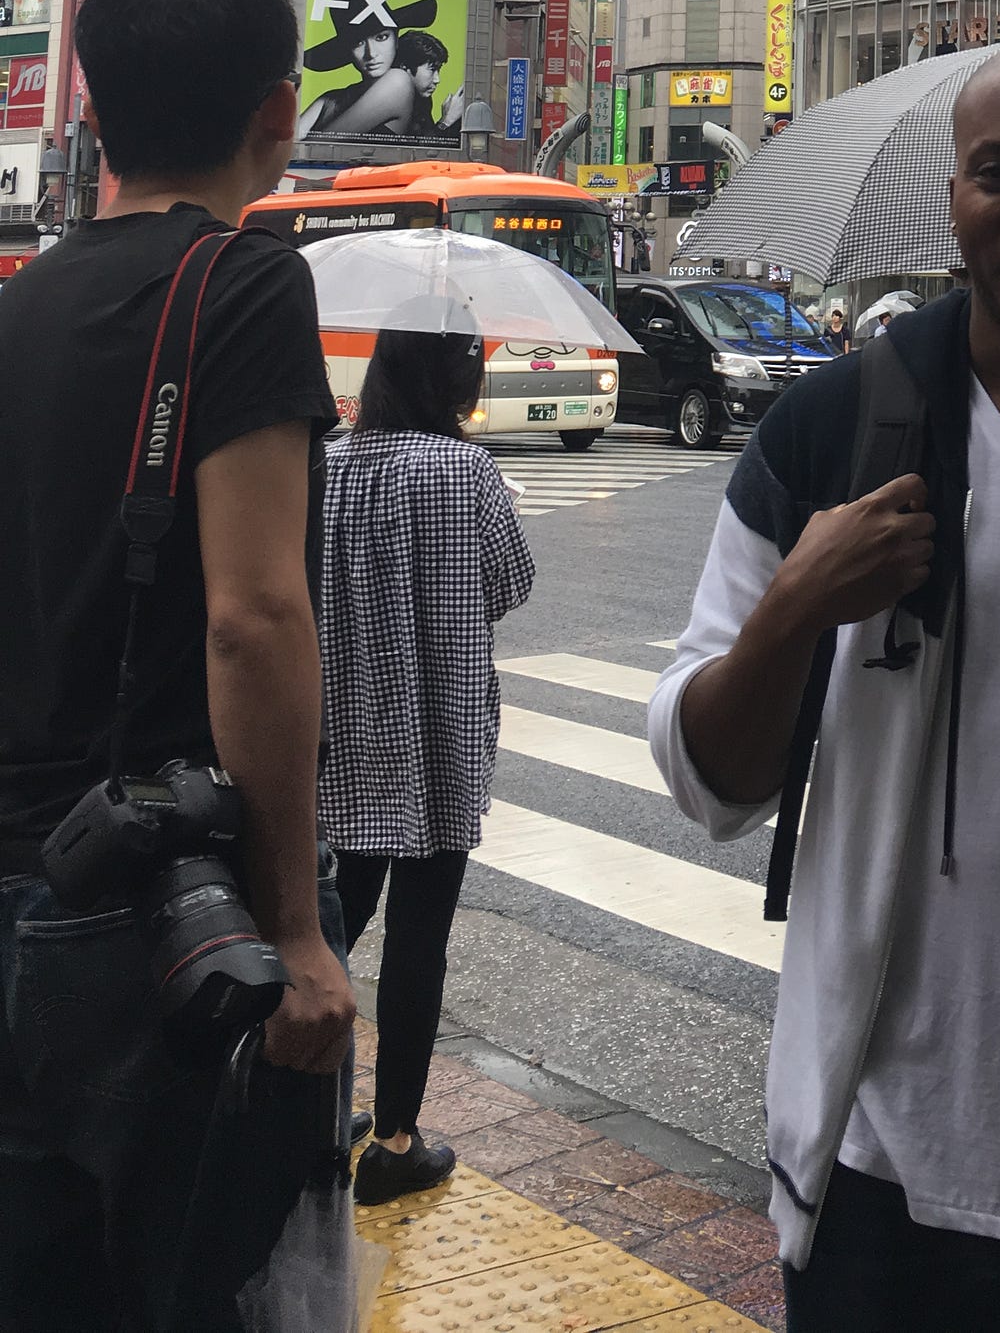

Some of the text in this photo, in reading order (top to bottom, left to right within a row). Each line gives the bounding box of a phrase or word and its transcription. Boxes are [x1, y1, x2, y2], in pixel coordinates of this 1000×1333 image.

[547, 2, 567, 75] 三千里
[597, 60, 611, 68] JTB
[12, 63, 47, 97] JTB
[770, 86, 785, 98] 4F
[511, 63, 525, 136] 大盛堂商事ビル
[305, 213, 395, 230] SHIBUYA community bus HACHIKO
[494, 217, 562, 230] 渋谷駅西口
[147, 383, 178, 466] Canon
